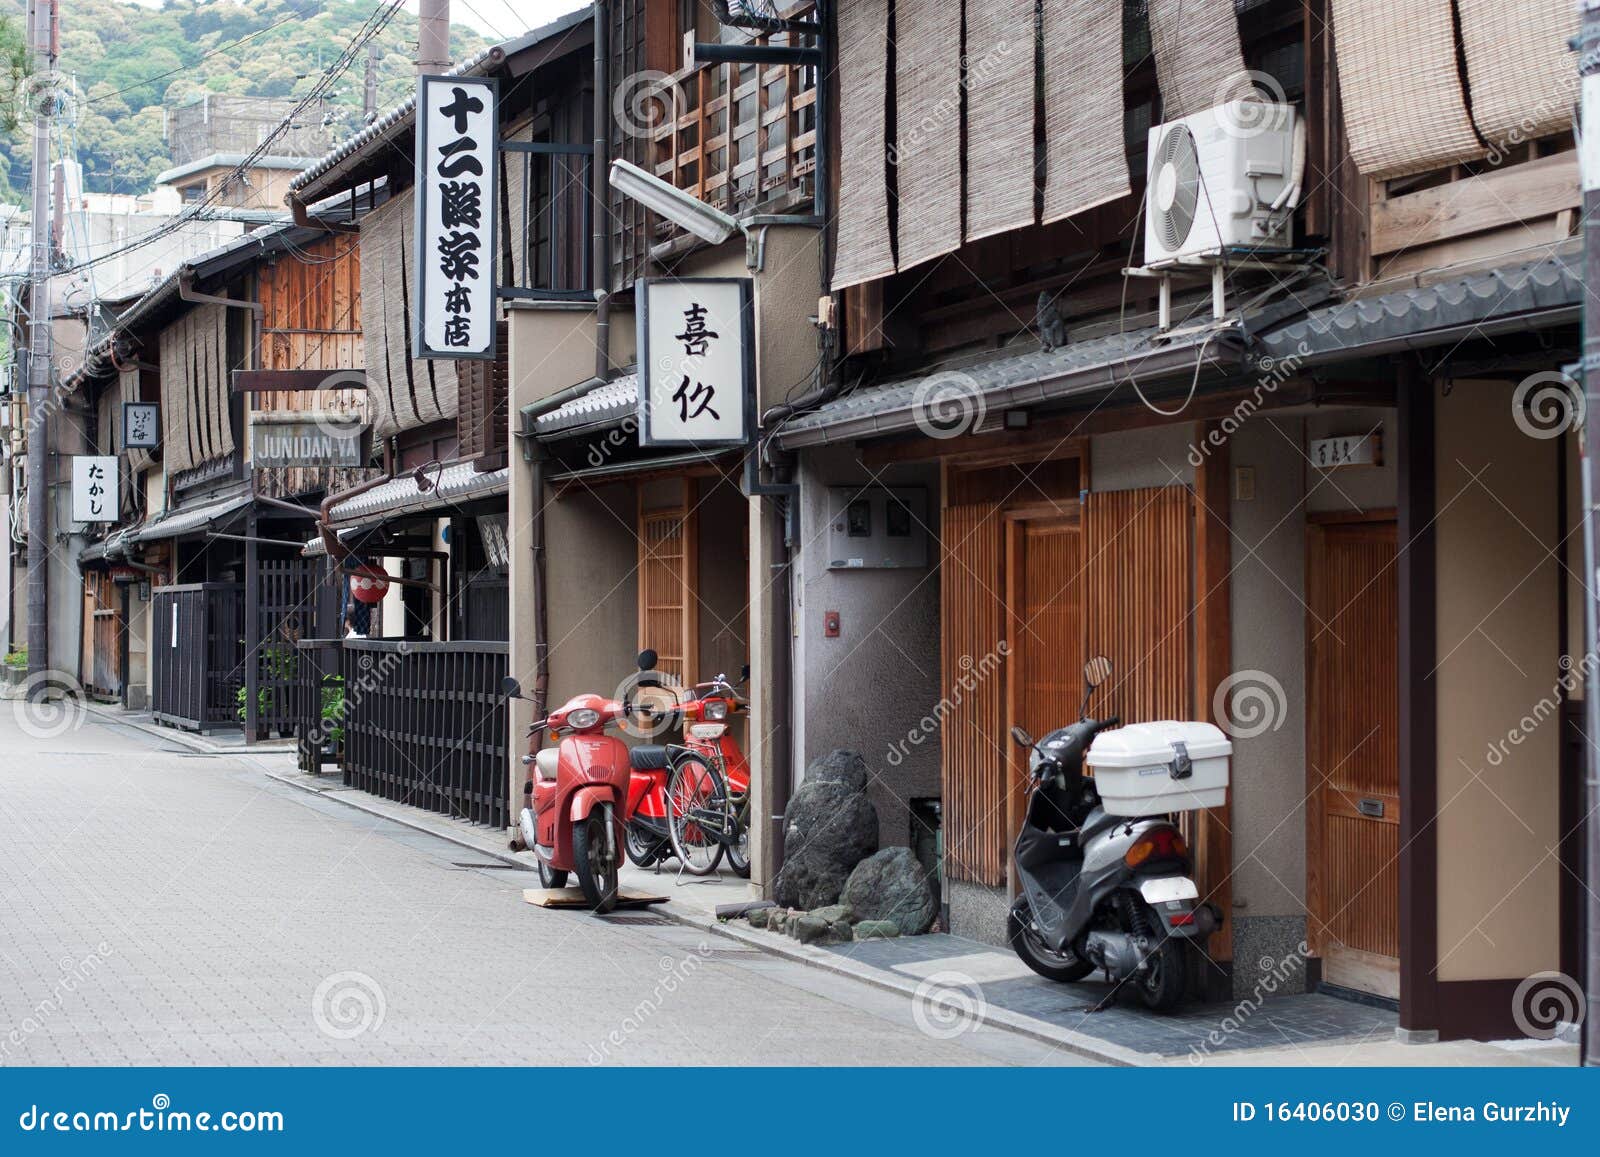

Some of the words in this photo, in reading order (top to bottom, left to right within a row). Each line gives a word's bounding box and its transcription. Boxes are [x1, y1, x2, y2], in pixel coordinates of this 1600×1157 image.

[258, 434, 356, 459] JUNIDAN-YA
[88, 463, 104, 515] たかし
